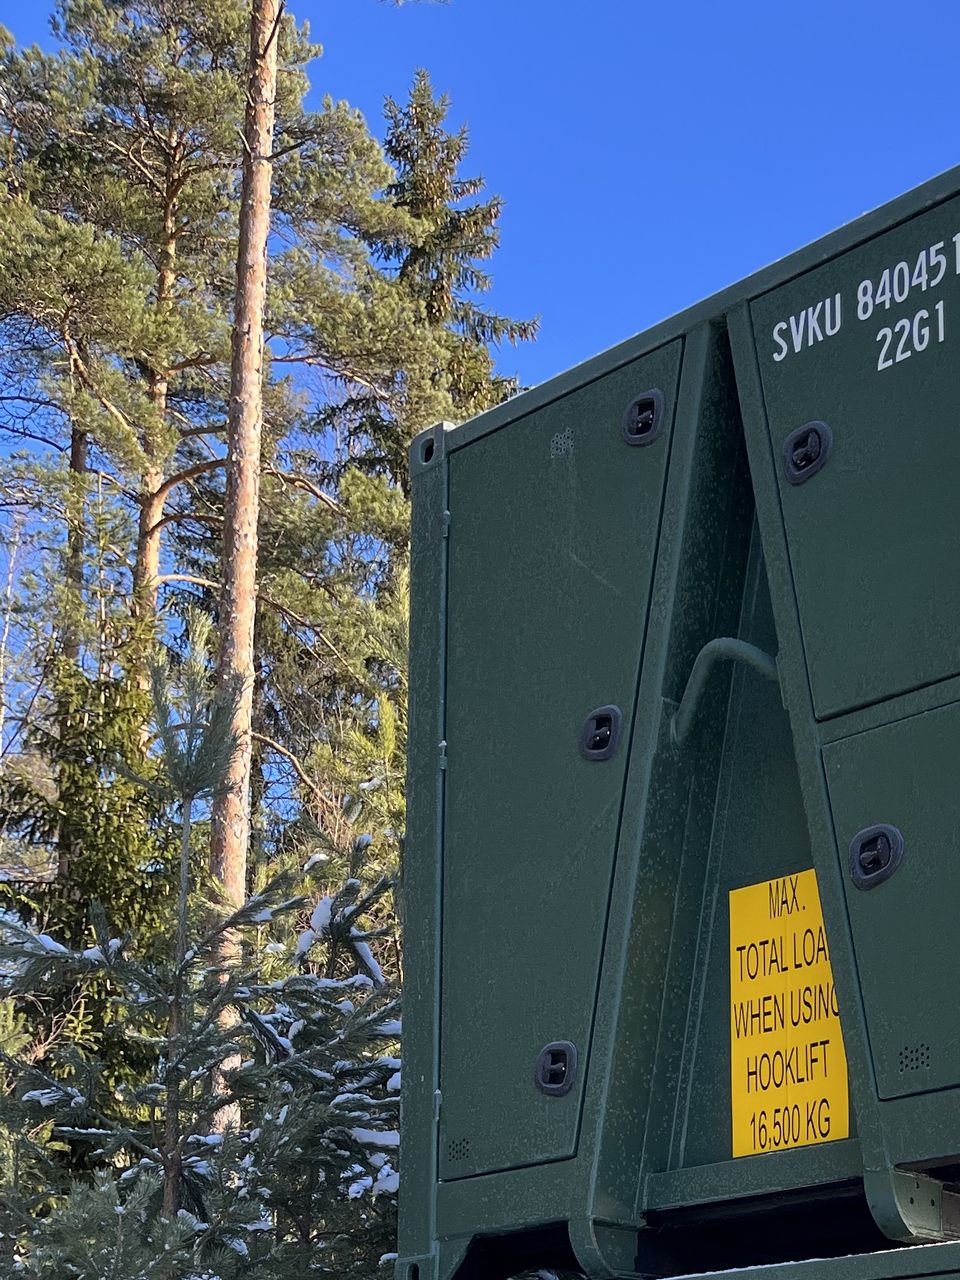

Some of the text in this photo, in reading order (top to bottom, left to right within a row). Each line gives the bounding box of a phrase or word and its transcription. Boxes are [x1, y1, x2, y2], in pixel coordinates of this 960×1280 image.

[772, 293, 841, 362] SVKU
[857, 232, 960, 322] 840451
[876, 300, 945, 372] 22G1
[769, 874, 806, 920] MAX.
[736, 926, 828, 982] TOTAL LOA
[734, 992, 786, 1039] WHEN
[747, 1040, 830, 1093] HOOKLIFT
[750, 1098, 831, 1151] 16,500 KG
